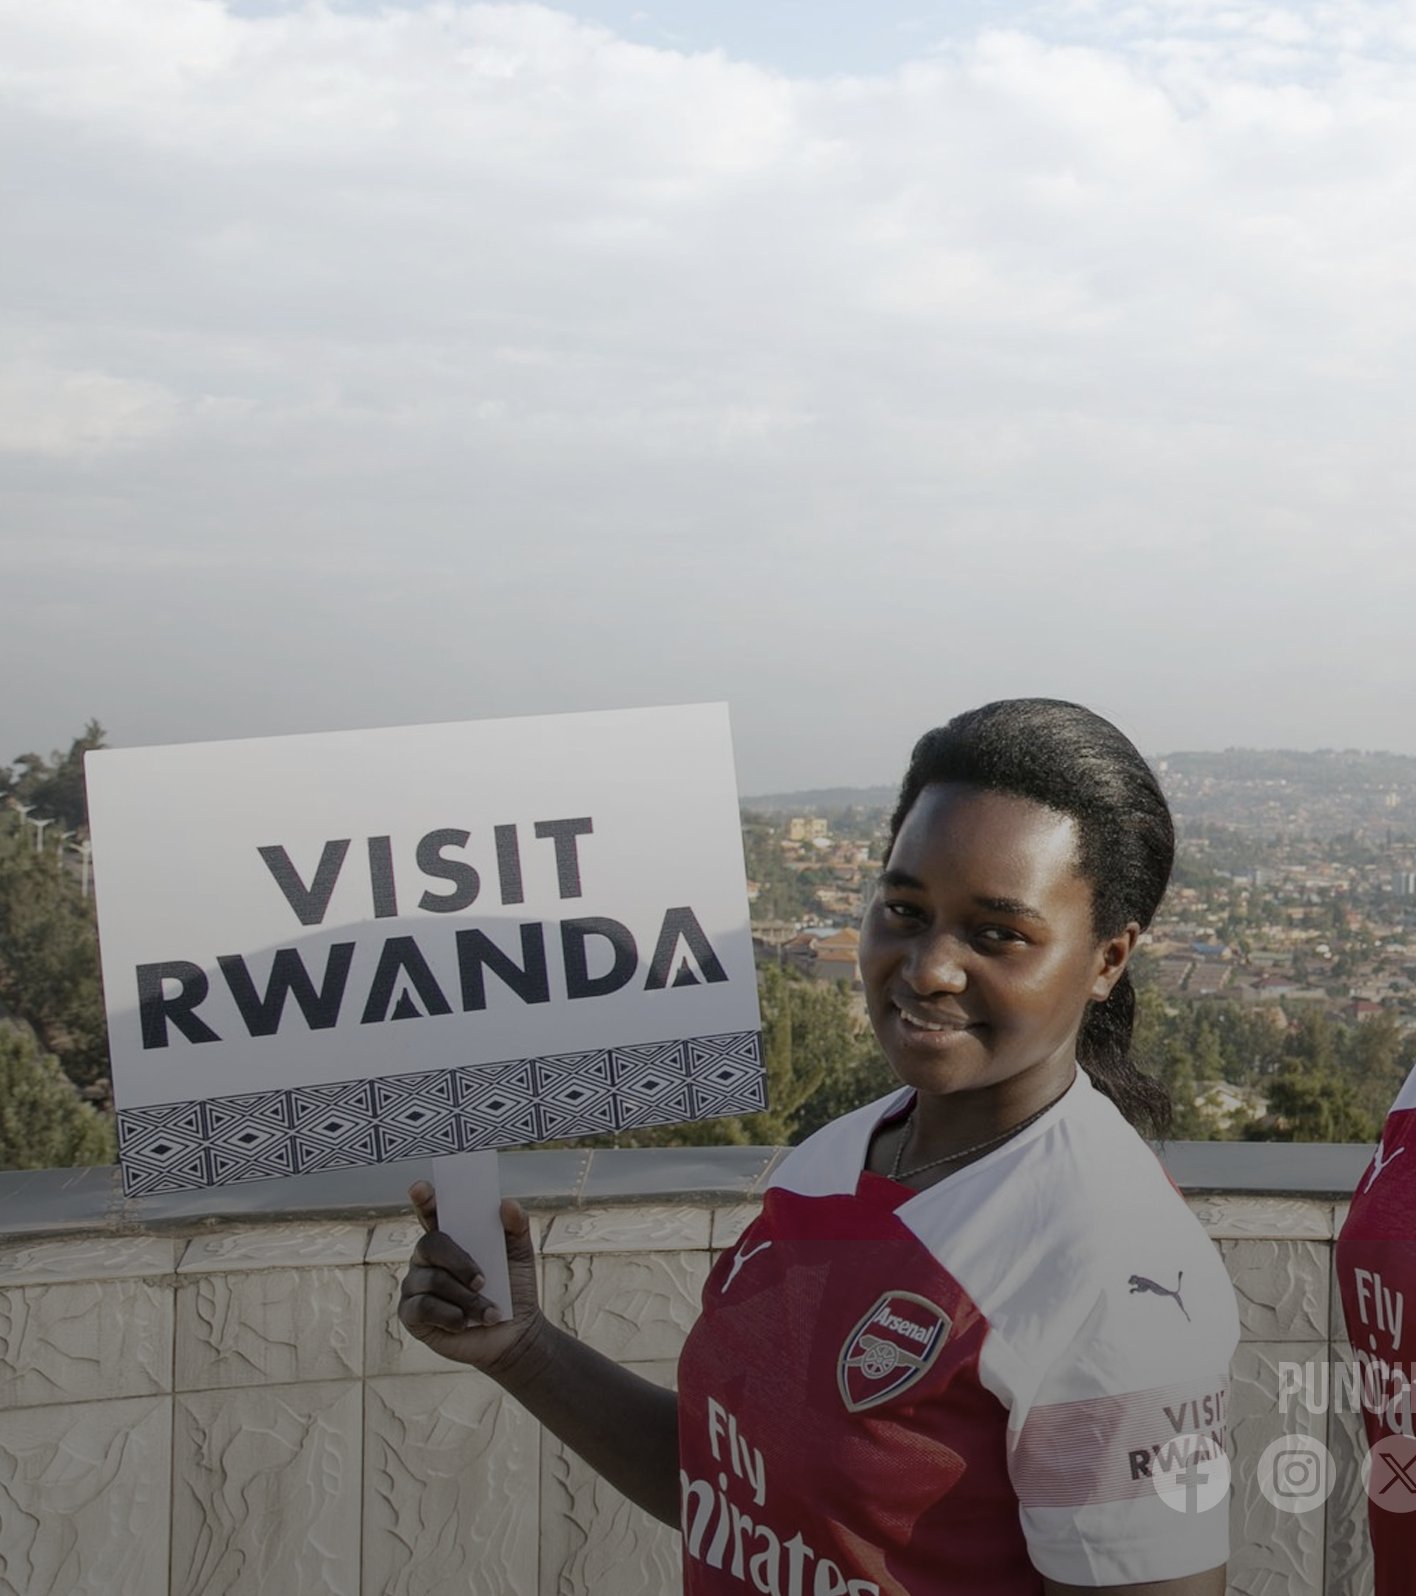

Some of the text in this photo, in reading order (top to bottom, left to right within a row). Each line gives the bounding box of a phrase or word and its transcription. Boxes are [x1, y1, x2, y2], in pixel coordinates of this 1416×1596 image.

[257, 817, 594, 926] VISIT
[136, 906, 729, 1050] RWANDA
[872, 1306, 934, 1344] Arsenal
[1354, 1267, 1404, 1350] Fly
[708, 1396, 766, 1507] Fly
[1128, 1425, 1227, 1481] RWAN
[1163, 1390, 1225, 1434] VISI
